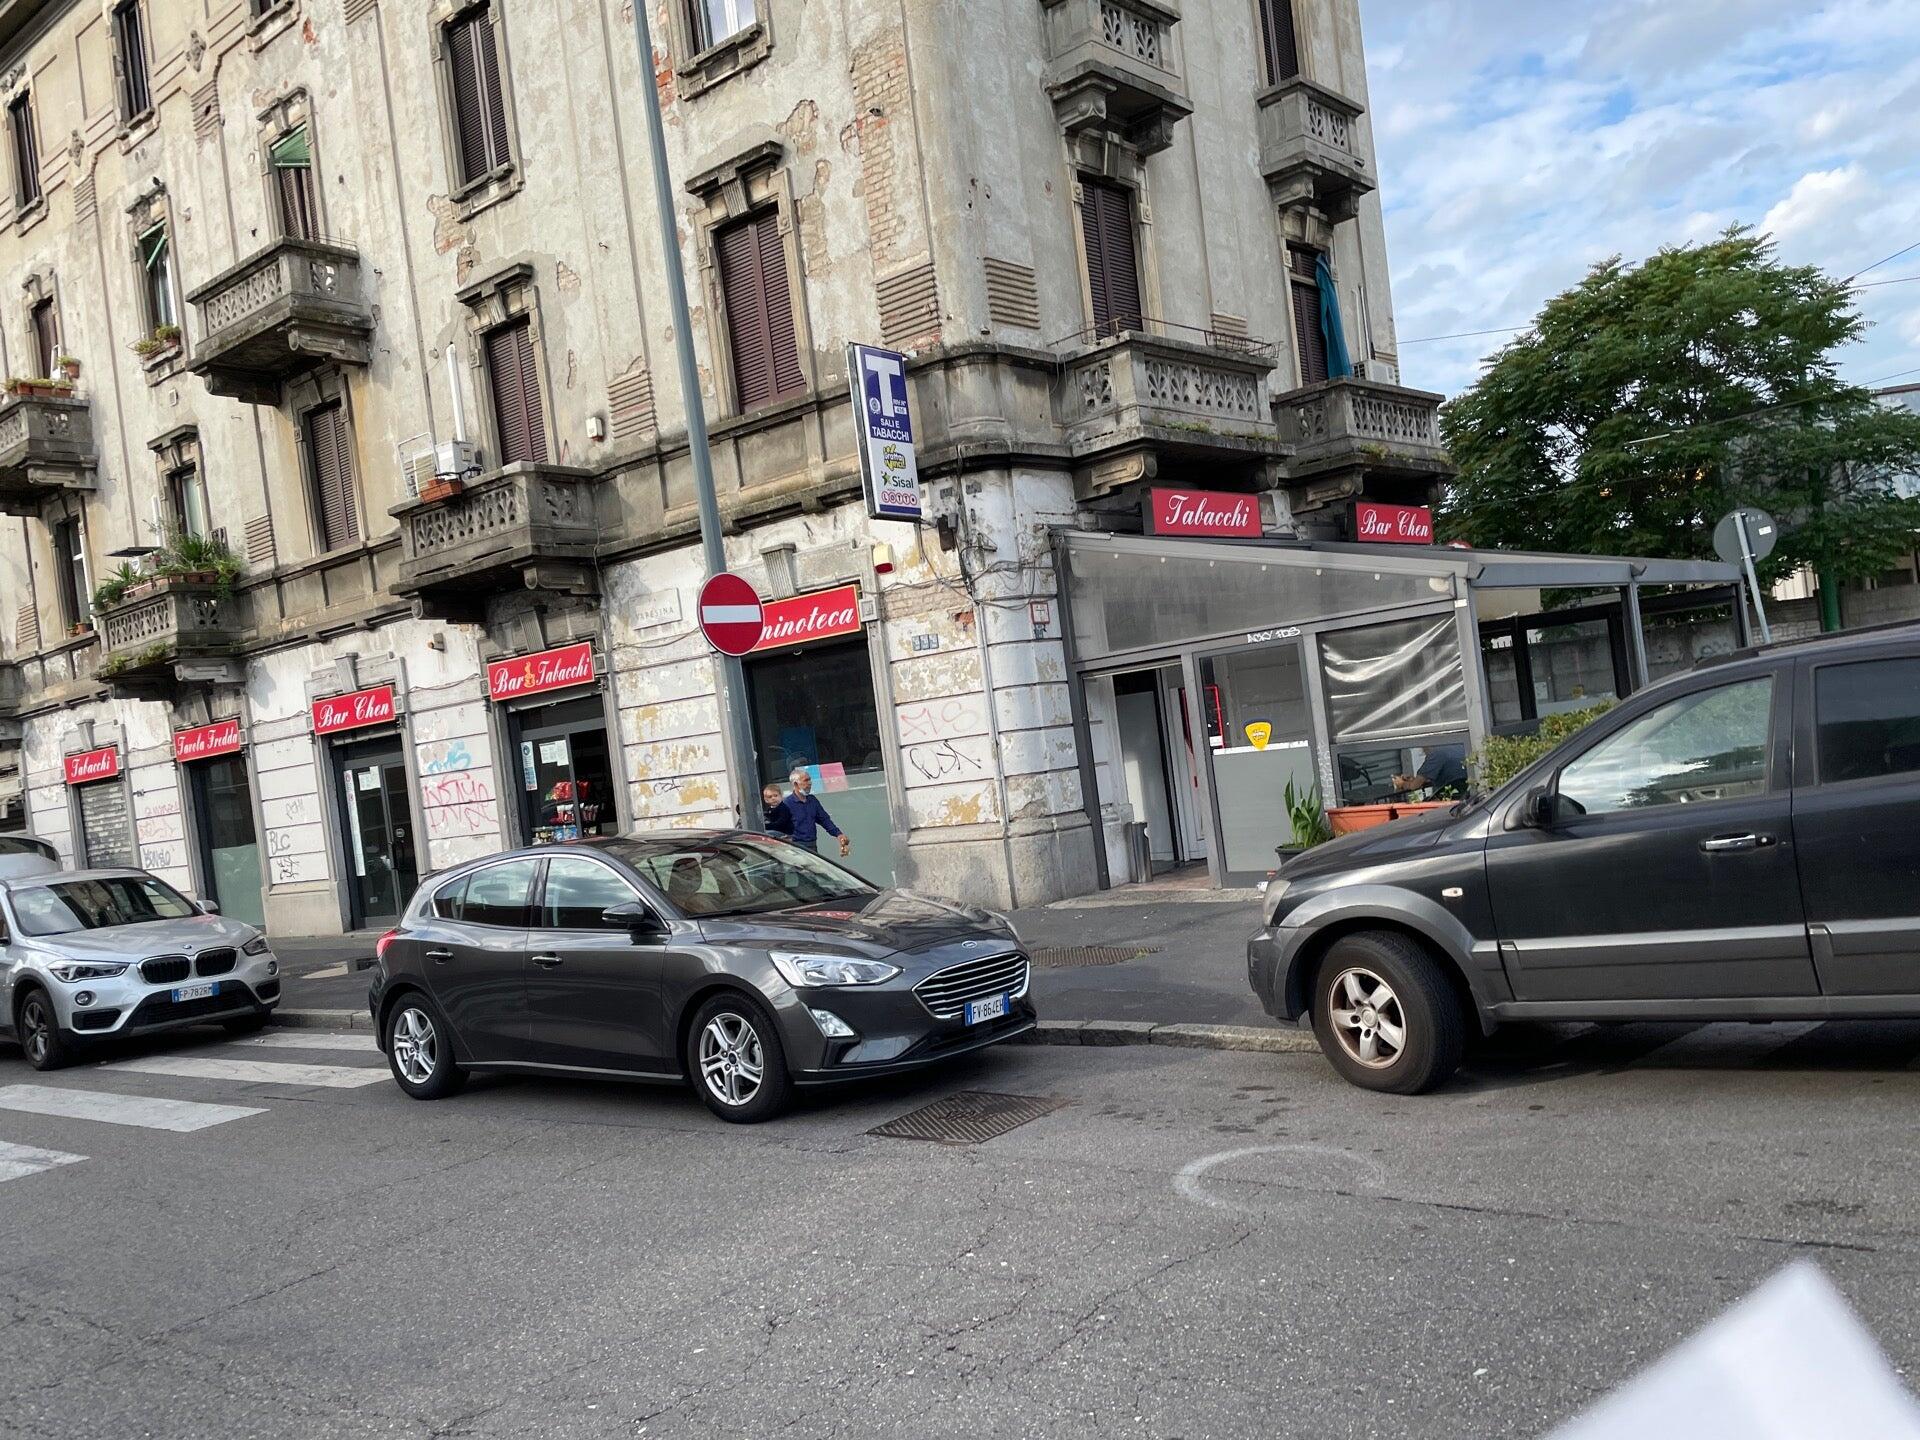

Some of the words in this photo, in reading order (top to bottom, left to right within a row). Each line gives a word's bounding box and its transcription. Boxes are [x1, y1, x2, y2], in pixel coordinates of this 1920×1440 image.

[865, 354, 901, 418] T
[872, 426, 910, 442] TABACCHI
[880, 418, 895, 428] SALI
[895, 420, 900, 428] E
[892, 475, 914, 488] Sisal
[882, 491, 917, 505] LOTTO
[1165, 494, 1250, 528] Tabacchi
[1360, 509, 1392, 536] Bar
[1398, 510, 1429, 537] Chen
[760, 606, 855, 642] ninoteca
[493, 668, 524, 694] Bar
[536, 653, 590, 685] Tabacchi
[318, 704, 349, 728] Bar
[354, 694, 390, 721] Chen
[176, 732, 205, 756] Tavola
[206, 727, 238, 750] Fredda
[71, 752, 111, 778] Tabacchi
